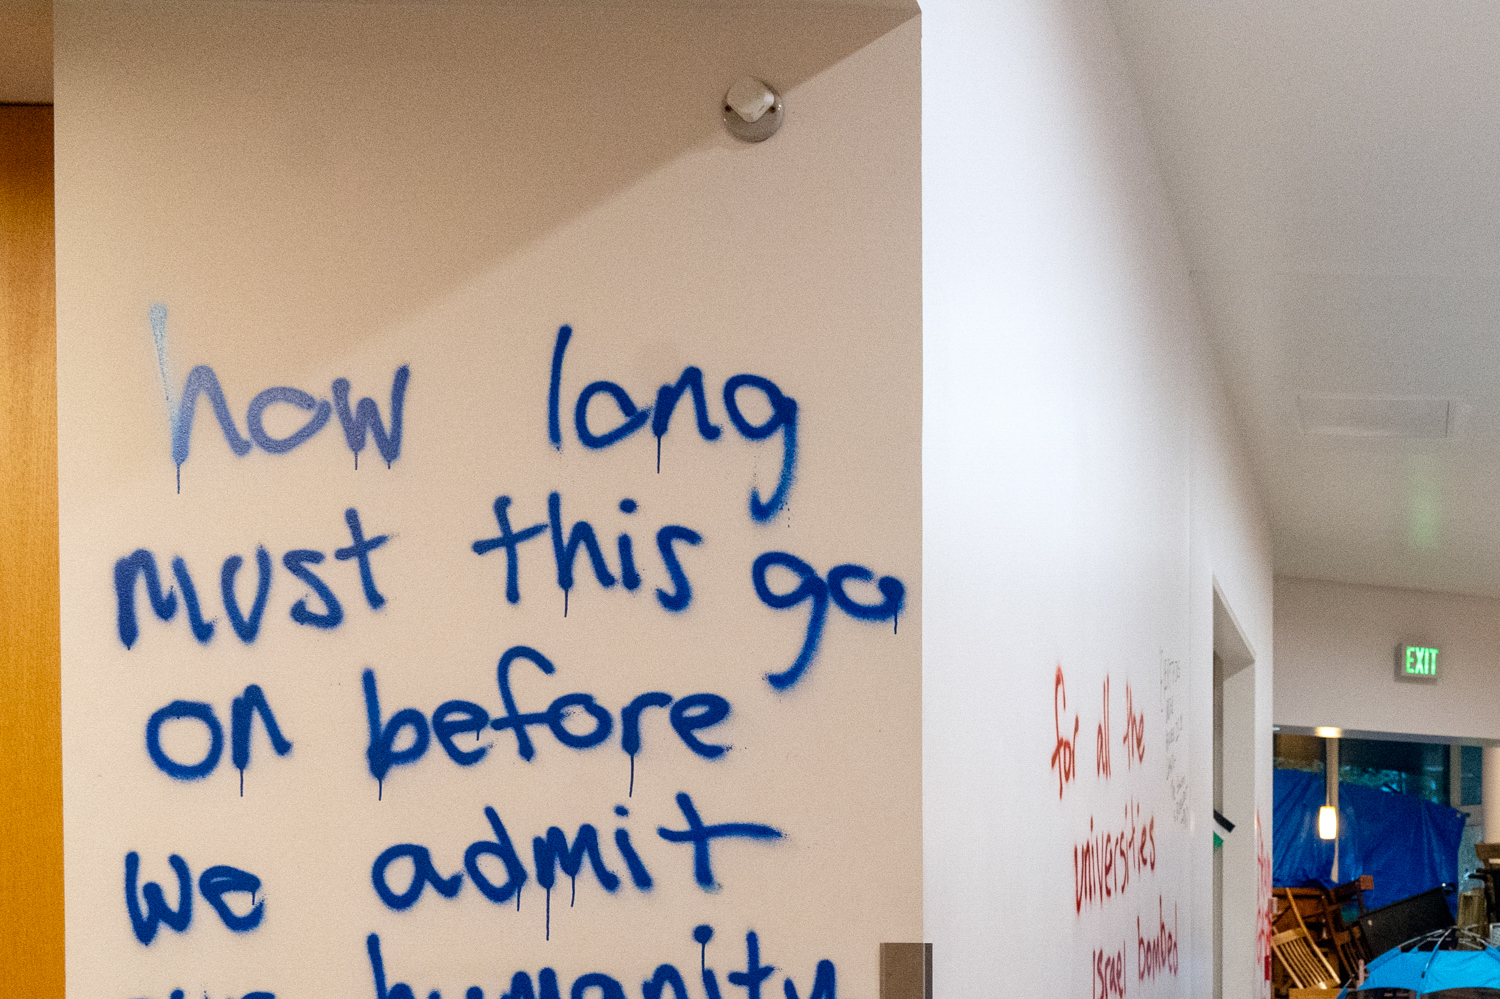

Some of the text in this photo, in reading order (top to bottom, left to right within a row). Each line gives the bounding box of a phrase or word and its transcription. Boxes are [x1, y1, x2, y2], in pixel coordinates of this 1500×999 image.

[148, 303, 799, 521] how long
[113, 493, 907, 690] must this go
[145, 645, 733, 784] on before
[1406, 646, 1439, 675] EXIT
[1097, 673, 1111, 779] all
[1122, 679, 1146, 770] the
[124, 791, 785, 945] we admit
[1073, 796, 1156, 915] universities
[1136, 895, 1180, 982] bombed
